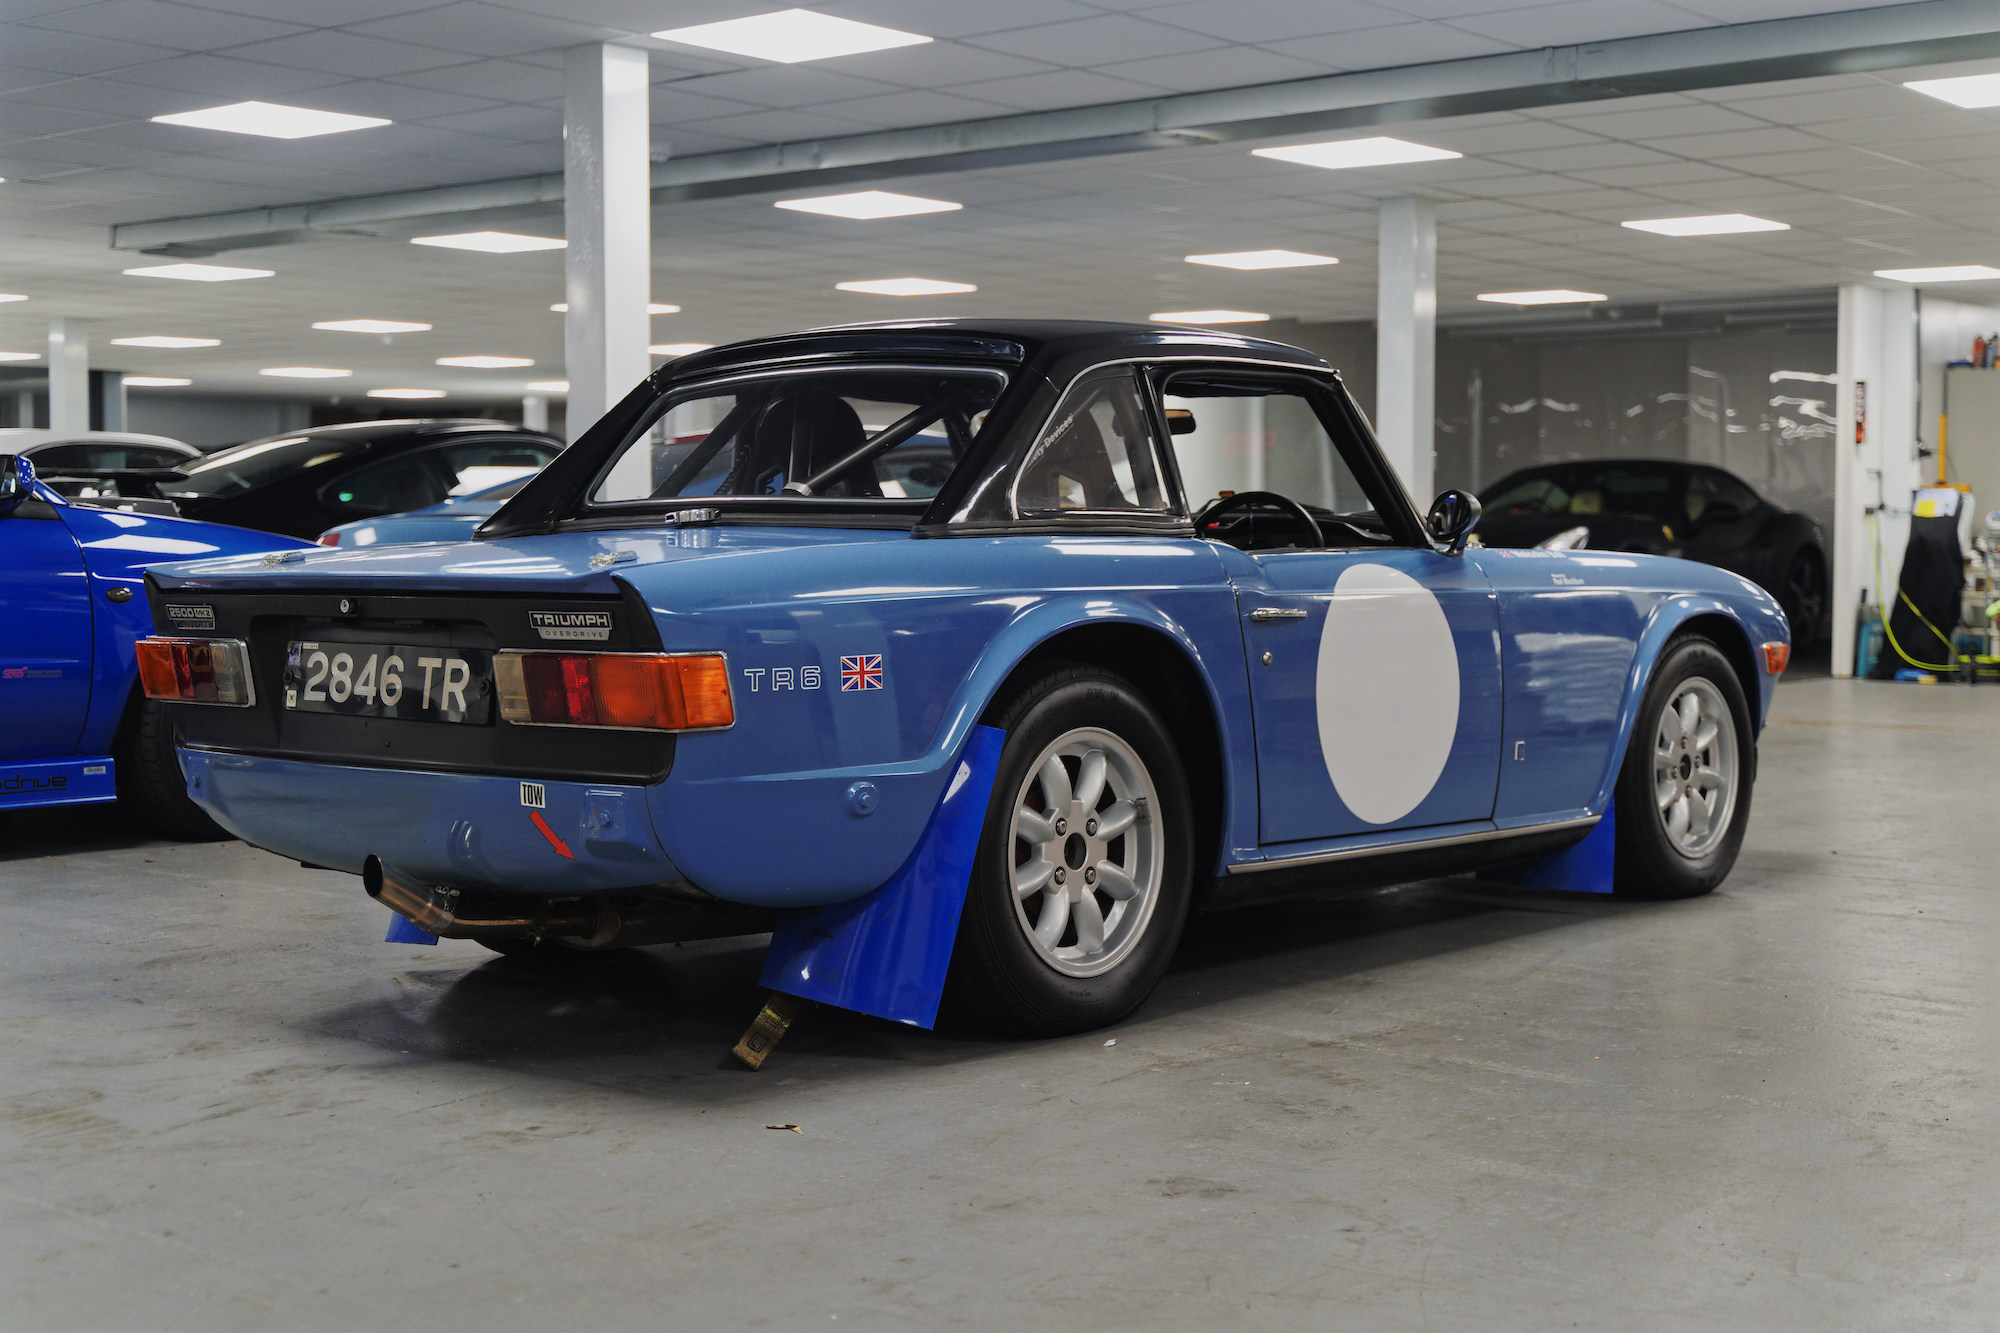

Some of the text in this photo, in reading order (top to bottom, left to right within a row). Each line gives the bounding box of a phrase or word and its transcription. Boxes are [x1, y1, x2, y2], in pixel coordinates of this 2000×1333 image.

[1043, 415, 1073, 448] Devices
[169, 607, 195, 618] 2500
[532, 613, 609, 626] TRIUMPH
[545, 630, 604, 638] OVERDRIVE
[304, 651, 471, 712] 2846 TR
[743, 665, 822, 692] TR6
[0, 774, 68, 790] drive
[521, 783, 543, 806] TOW
